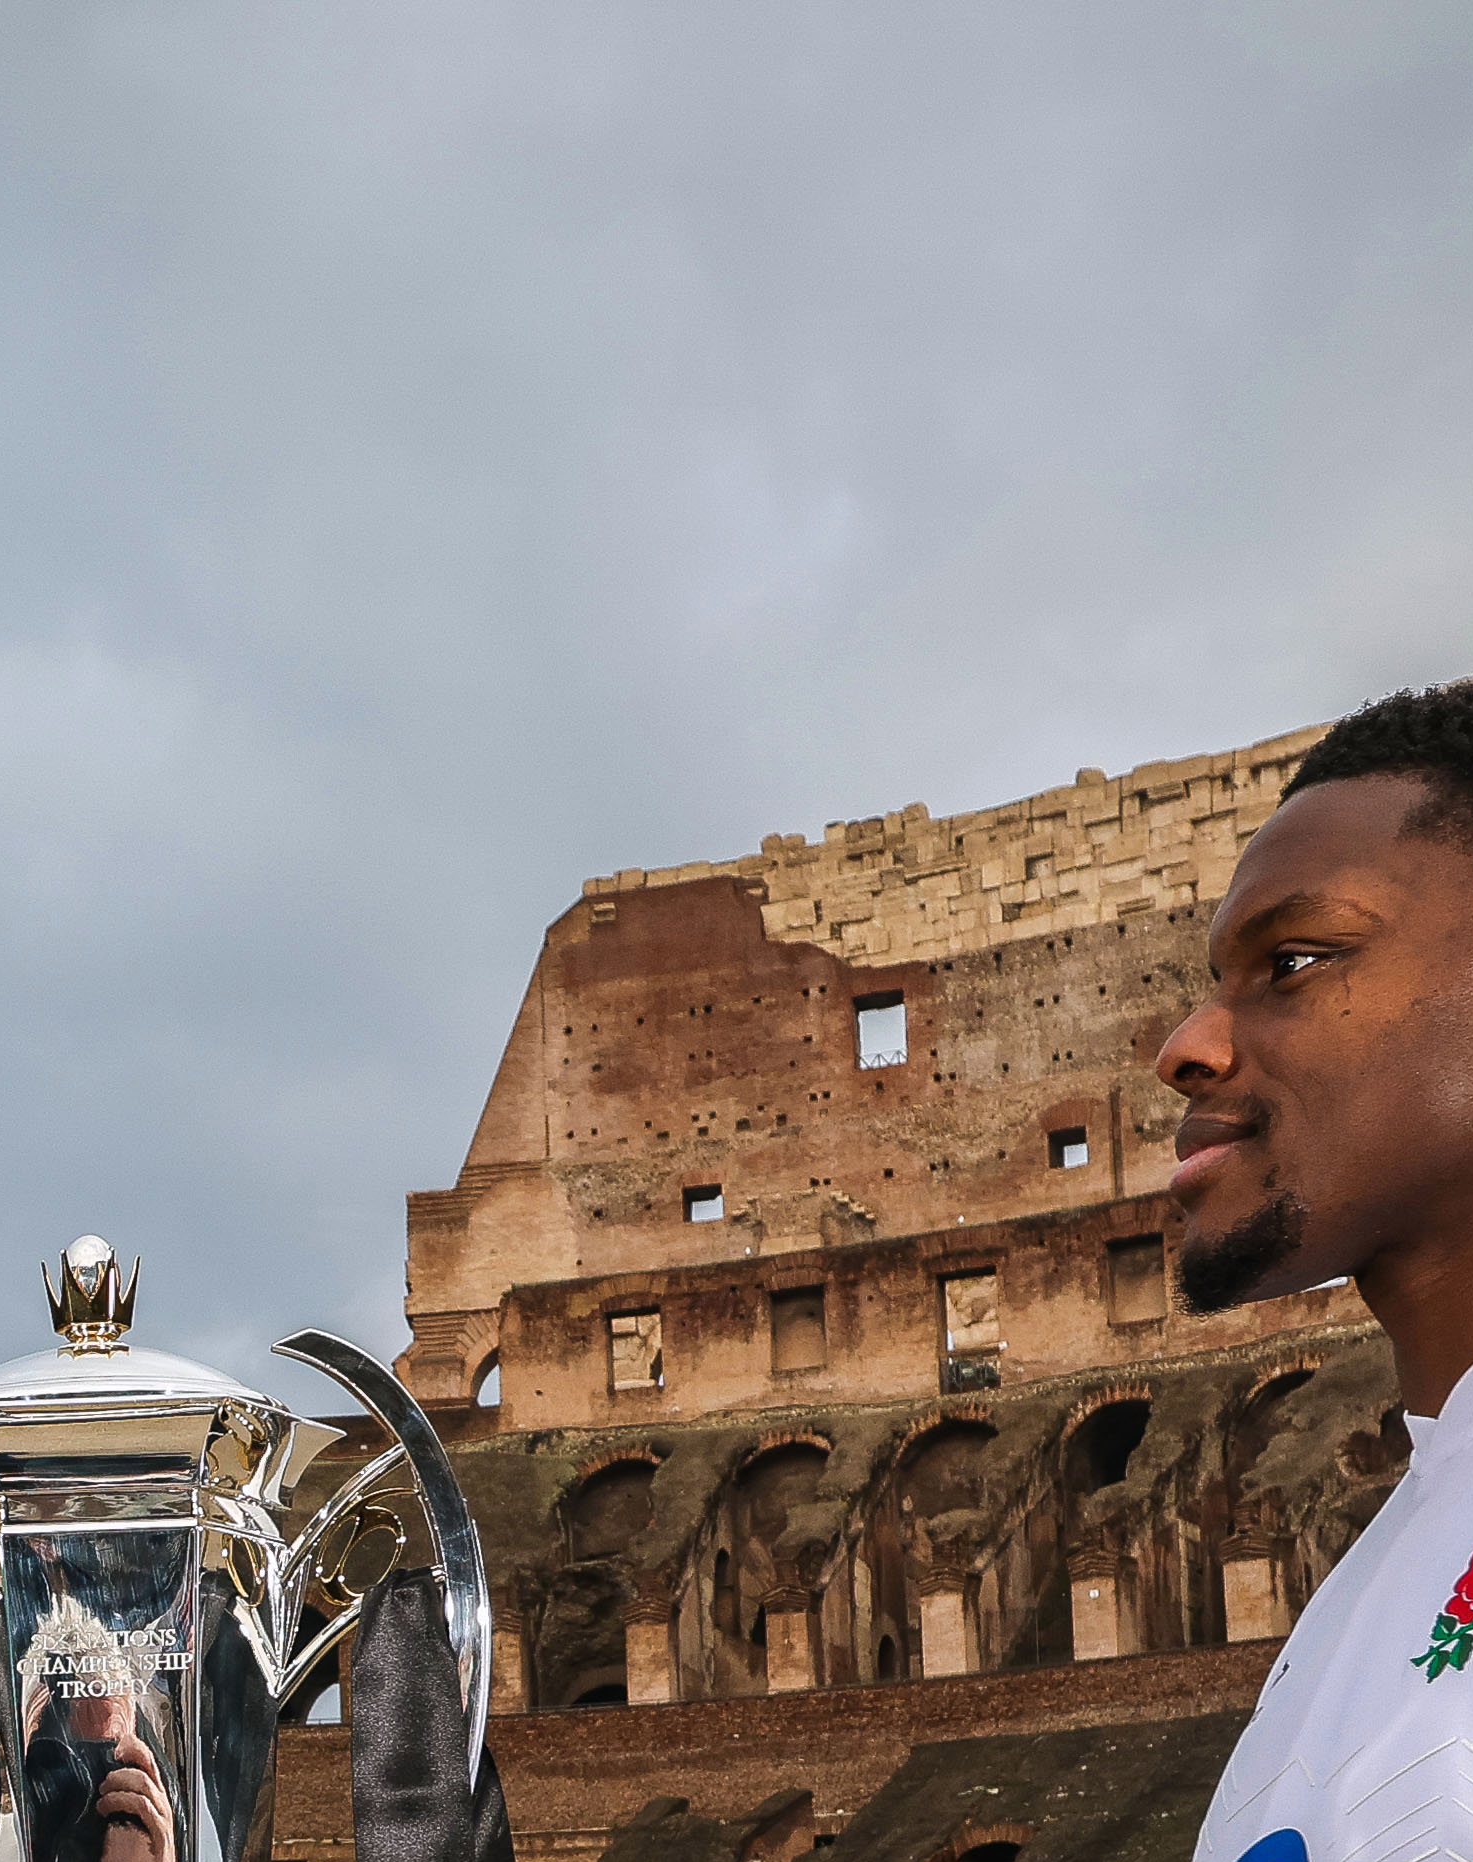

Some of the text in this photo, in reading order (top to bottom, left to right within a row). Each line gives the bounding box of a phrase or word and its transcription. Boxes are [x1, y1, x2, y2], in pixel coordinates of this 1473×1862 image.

[75, 1628, 178, 1649] NATIONS
[16, 1652, 195, 1675] CHAMPIONSHIP
[56, 1678, 153, 1698] TROPHY
